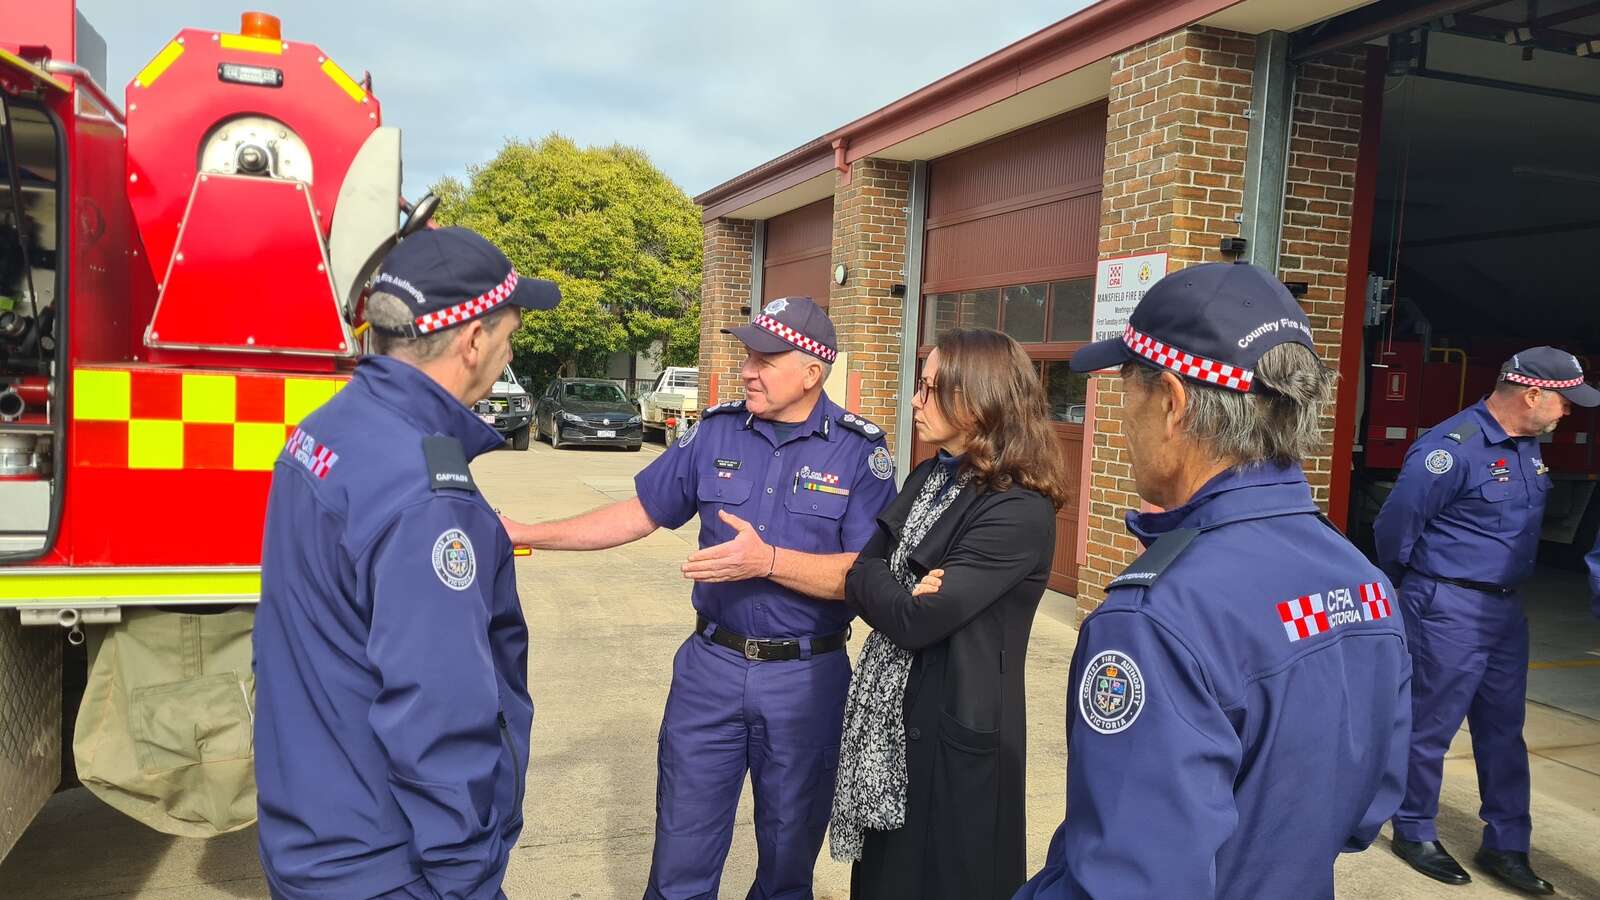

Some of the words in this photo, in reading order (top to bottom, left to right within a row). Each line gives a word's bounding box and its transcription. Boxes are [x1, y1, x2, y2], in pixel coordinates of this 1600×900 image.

[393, 276, 426, 304] Authority
[1109, 278, 1121, 286] CFA
[1097, 292, 1125, 302] MANSFIELD
[1125, 291, 1137, 301] FIRE
[1238, 319, 1280, 349] Country
[1280, 318, 1299, 329] Fire
[435, 473, 469, 483] CAPTAIN
[1327, 588, 1354, 612] CFA
[1083, 661, 1099, 699] COUNTRY
[1101, 655, 1117, 664] FIRE
[1120, 660, 1141, 706] AUTHORITY
[1089, 711, 1127, 730] VICTORIA
